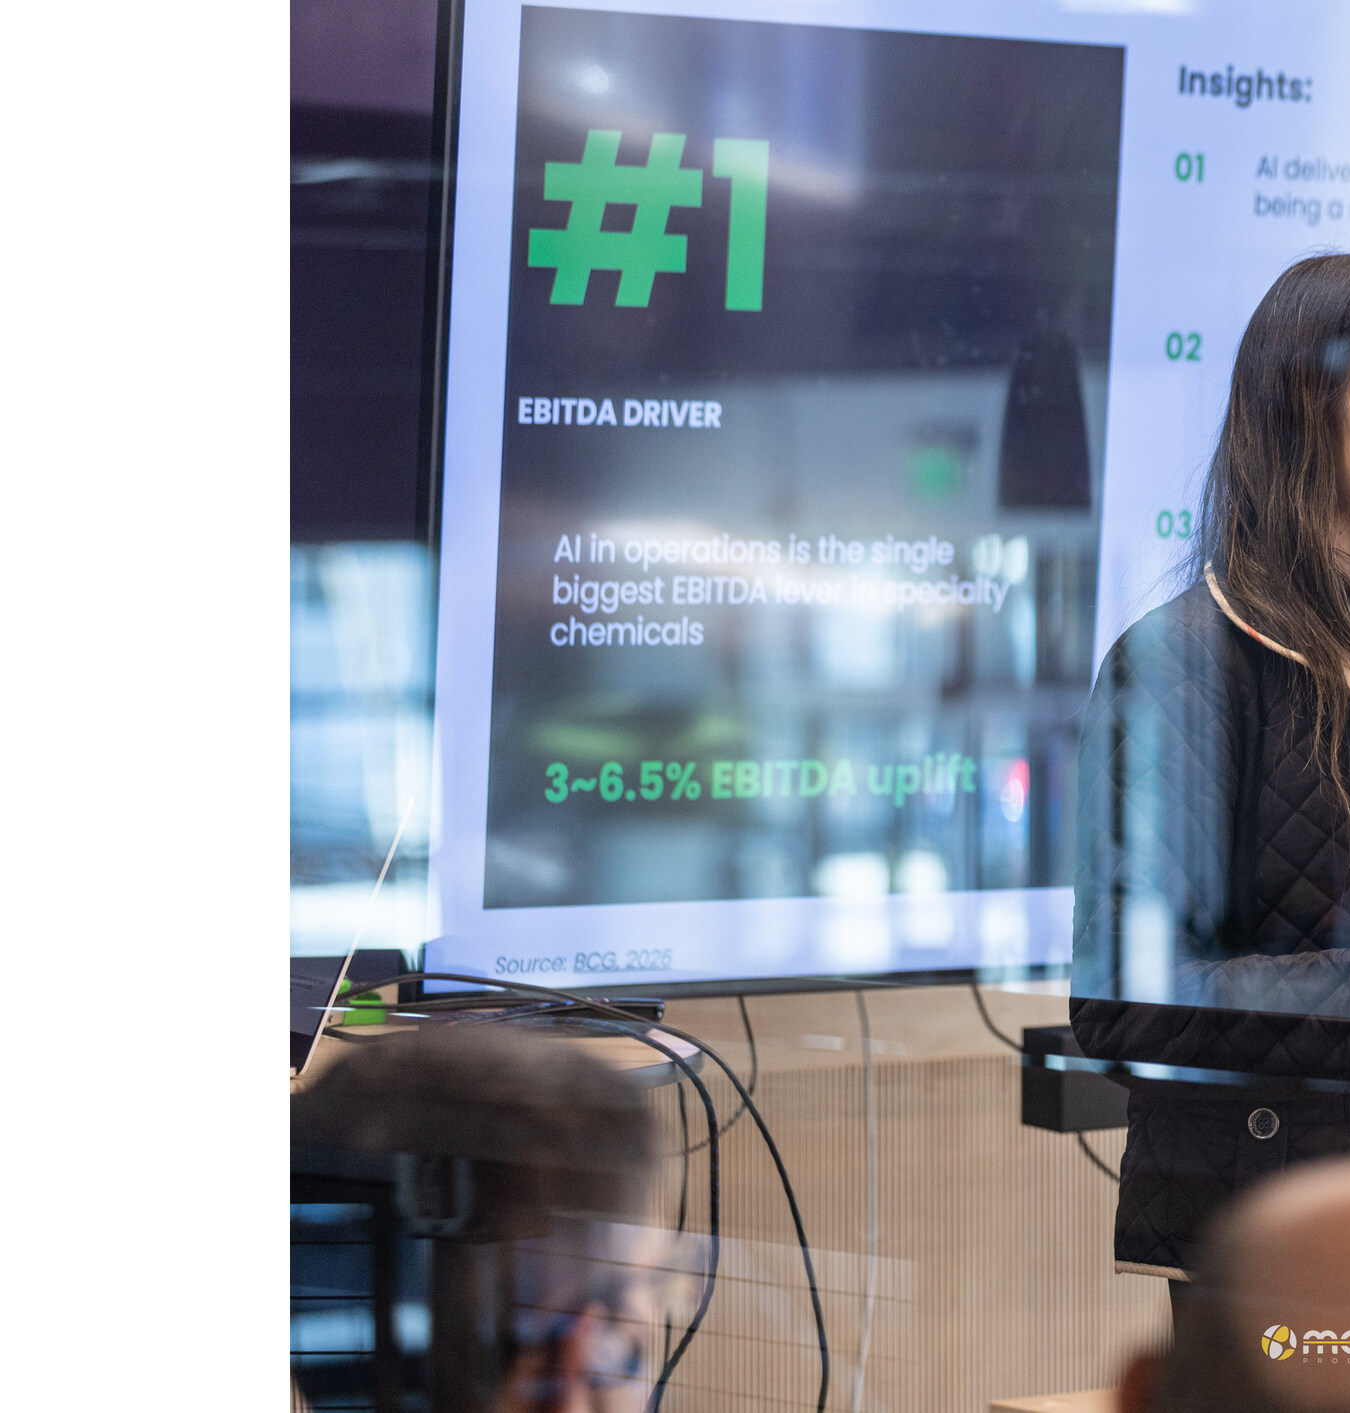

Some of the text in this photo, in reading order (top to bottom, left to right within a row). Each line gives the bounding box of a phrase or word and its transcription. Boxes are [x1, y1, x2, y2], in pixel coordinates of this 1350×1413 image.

[1179, 64, 1313, 108] Insights:
[1174, 152, 1205, 183] 01
[1256, 155, 1278, 180] AI
[527, 129, 770, 312] #1
[1254, 192, 1320, 227] being
[1326, 202, 1344, 221] a
[1165, 331, 1202, 362] 02
[517, 396, 723, 430] EBITDA DRIVER
[1156, 510, 1192, 540] 03
[553, 533, 955, 574] AI in operations is the single
[552, 574, 1011, 614] biggest EBITDA lever in specialty
[550, 615, 705, 647] chemicals
[544, 753, 977, 808] 3~6.5% EBITDA uplift
[495, 954, 568, 976] Source:
[626, 949, 674, 971] 2026
